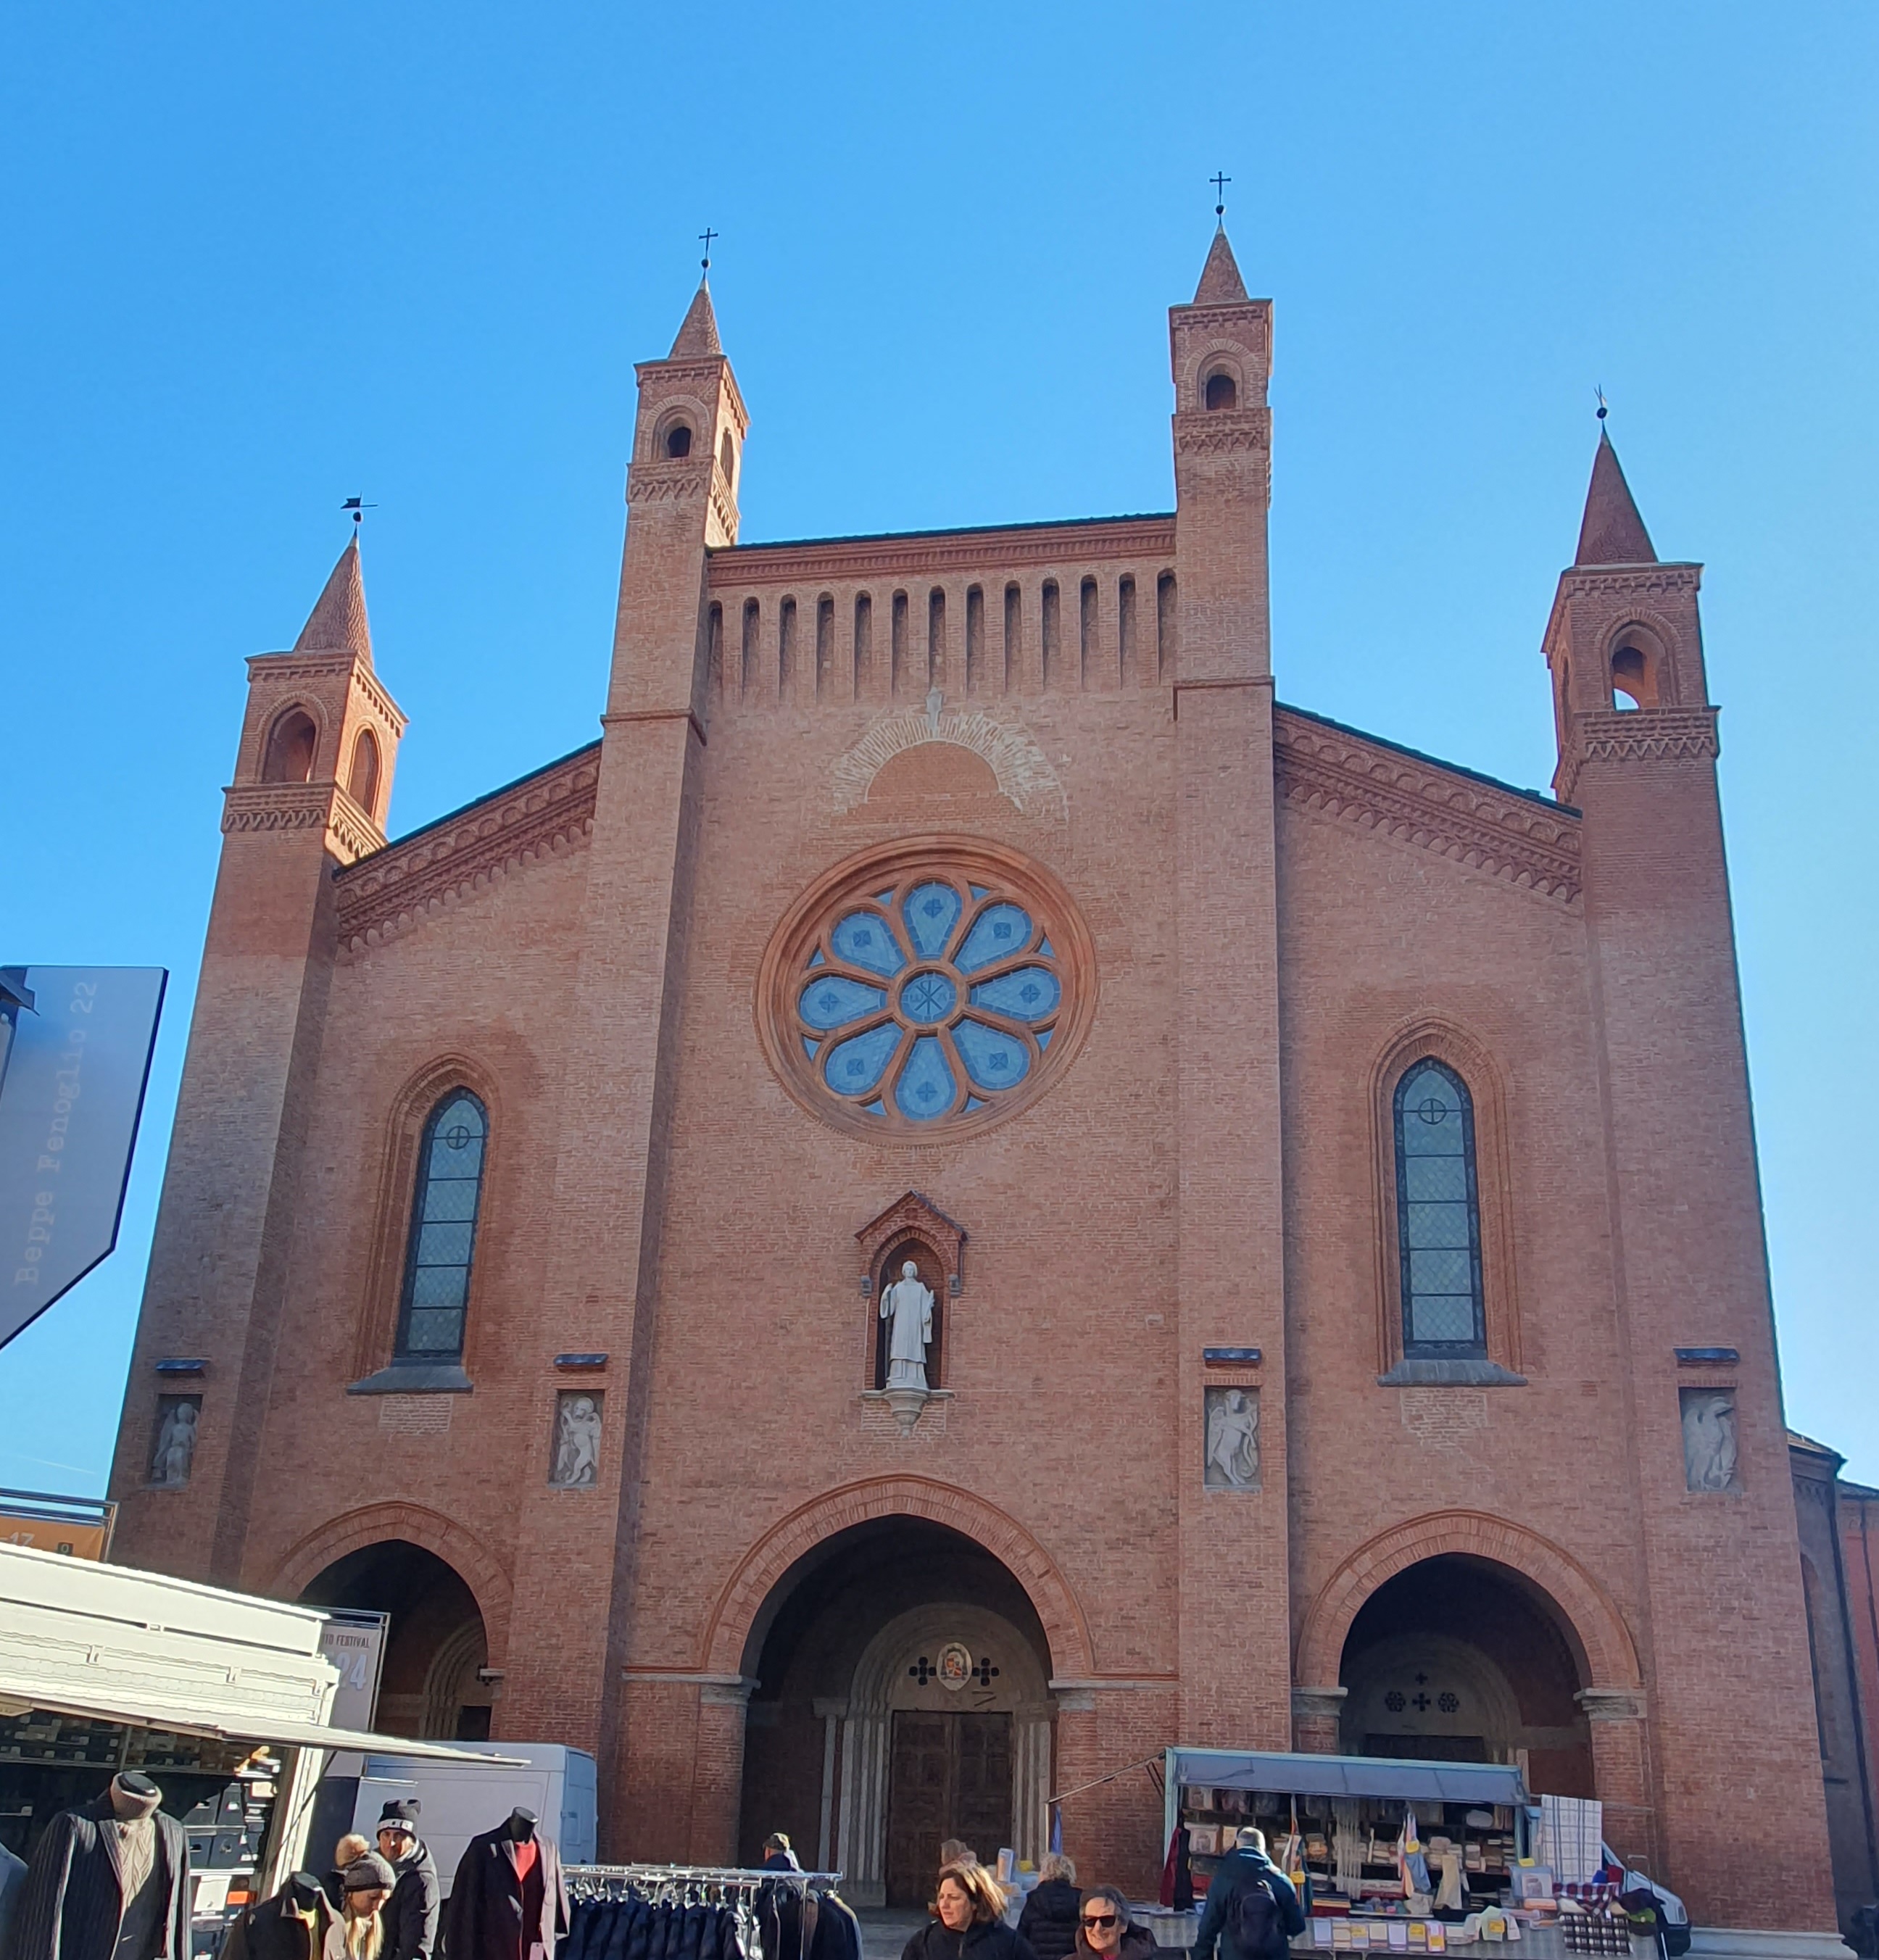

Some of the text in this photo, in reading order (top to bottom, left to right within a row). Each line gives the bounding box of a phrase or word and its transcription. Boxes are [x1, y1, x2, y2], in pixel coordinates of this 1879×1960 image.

[14, 981, 97, 1287] Beppe Fenoglio 22
[336, 1635, 370, 1648] FESTIVAL
[327, 1652, 367, 1690] 24
